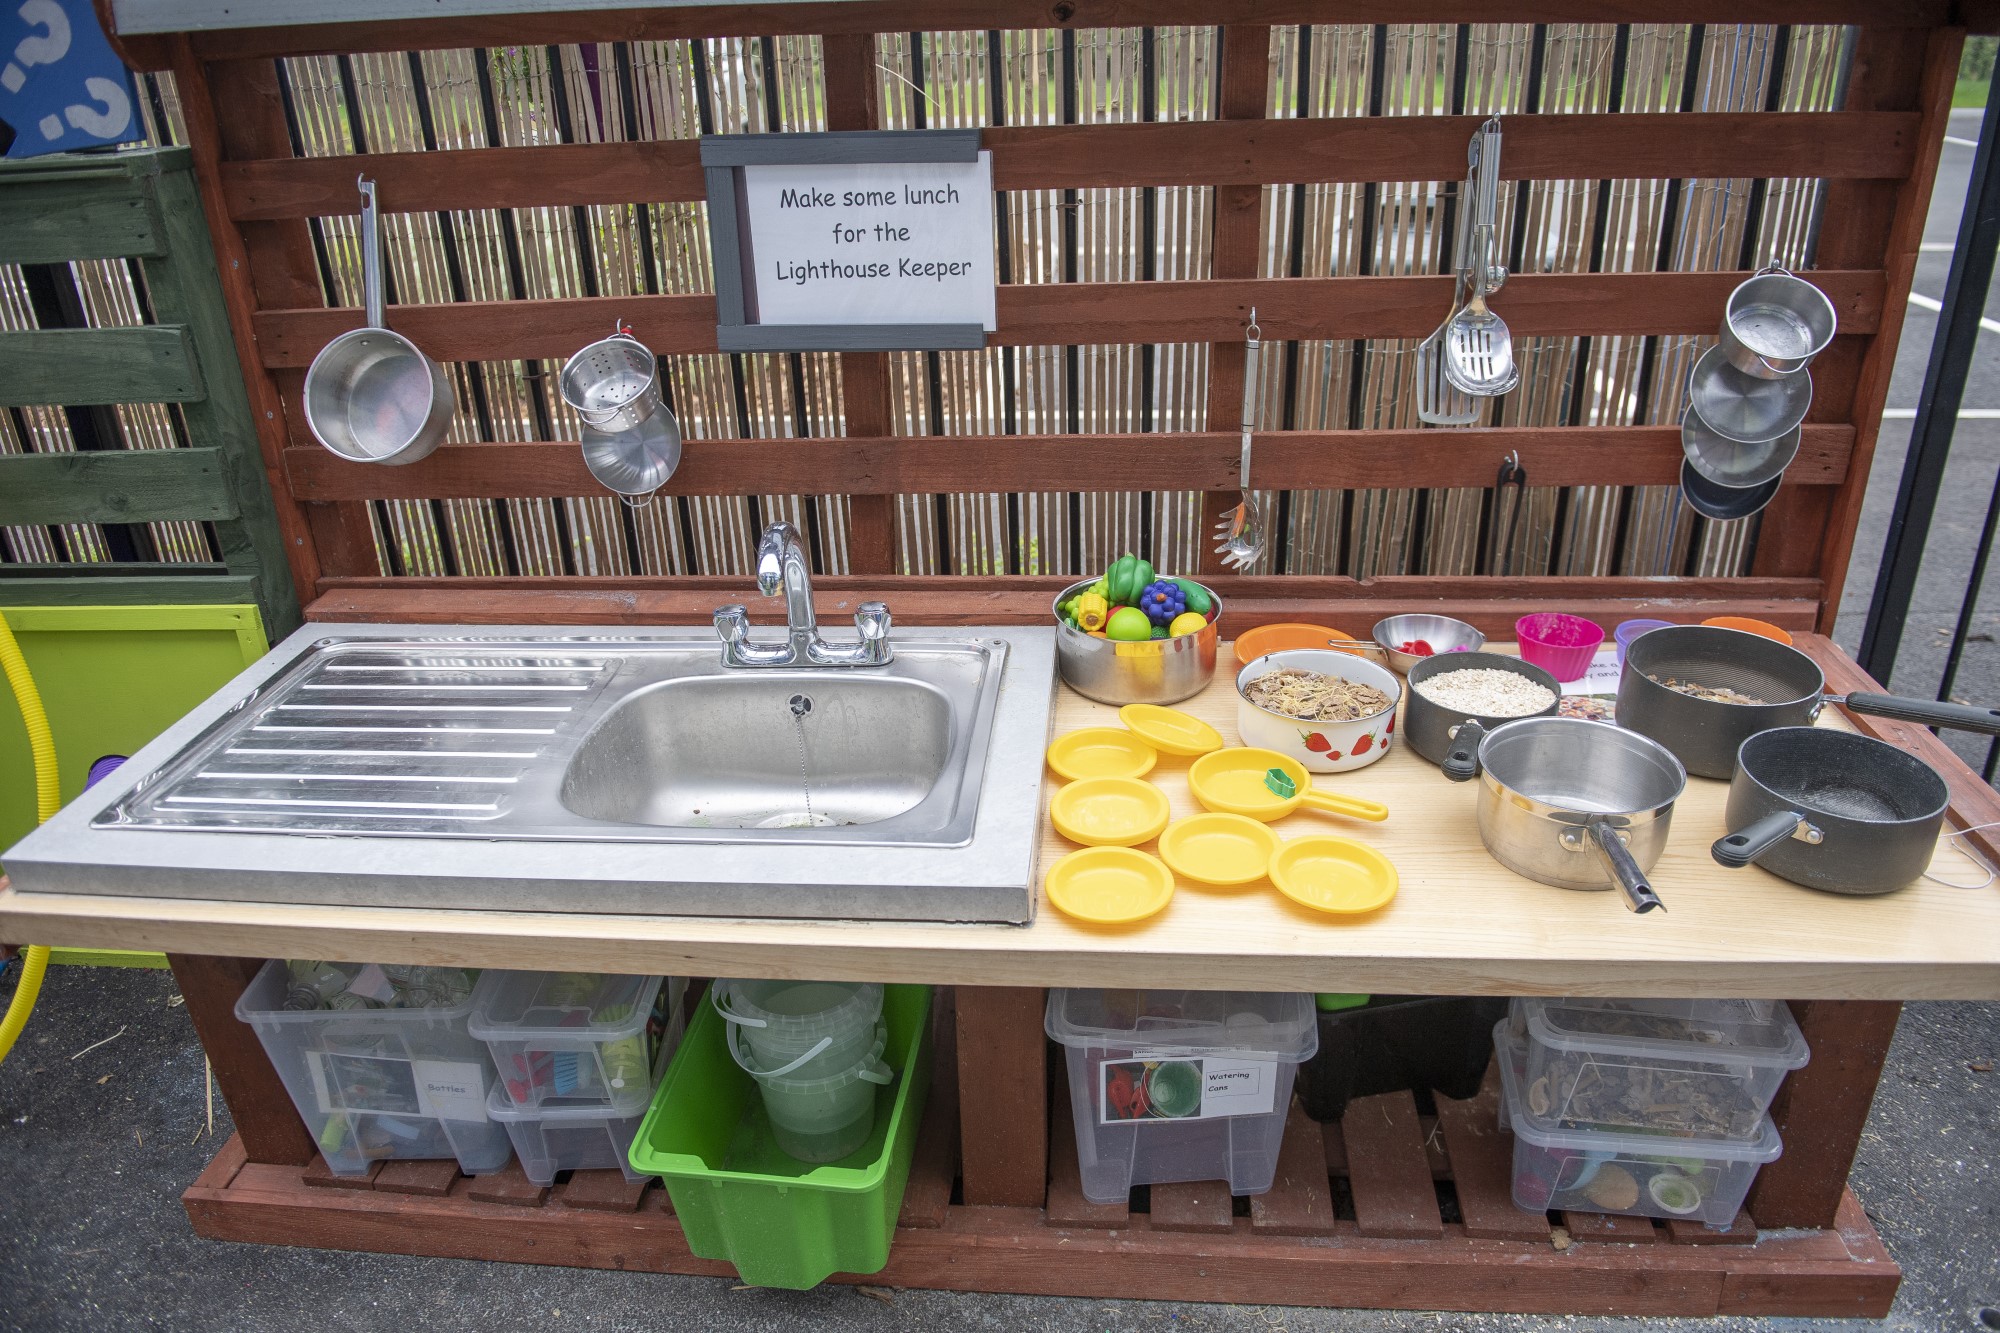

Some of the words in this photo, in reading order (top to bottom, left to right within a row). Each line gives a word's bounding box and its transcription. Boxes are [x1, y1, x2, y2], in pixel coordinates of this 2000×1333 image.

[780, 187, 836, 208] Make
[843, 190, 897, 207] some
[904, 183, 959, 205] lunch
[832, 222, 866, 244] for
[874, 222, 911, 242] the
[776, 258, 891, 285] Lighthouse
[898, 258, 972, 282] Keeper
[1208, 1072, 1250, 1081] Watering
[427, 1083, 466, 1094] Bottles
